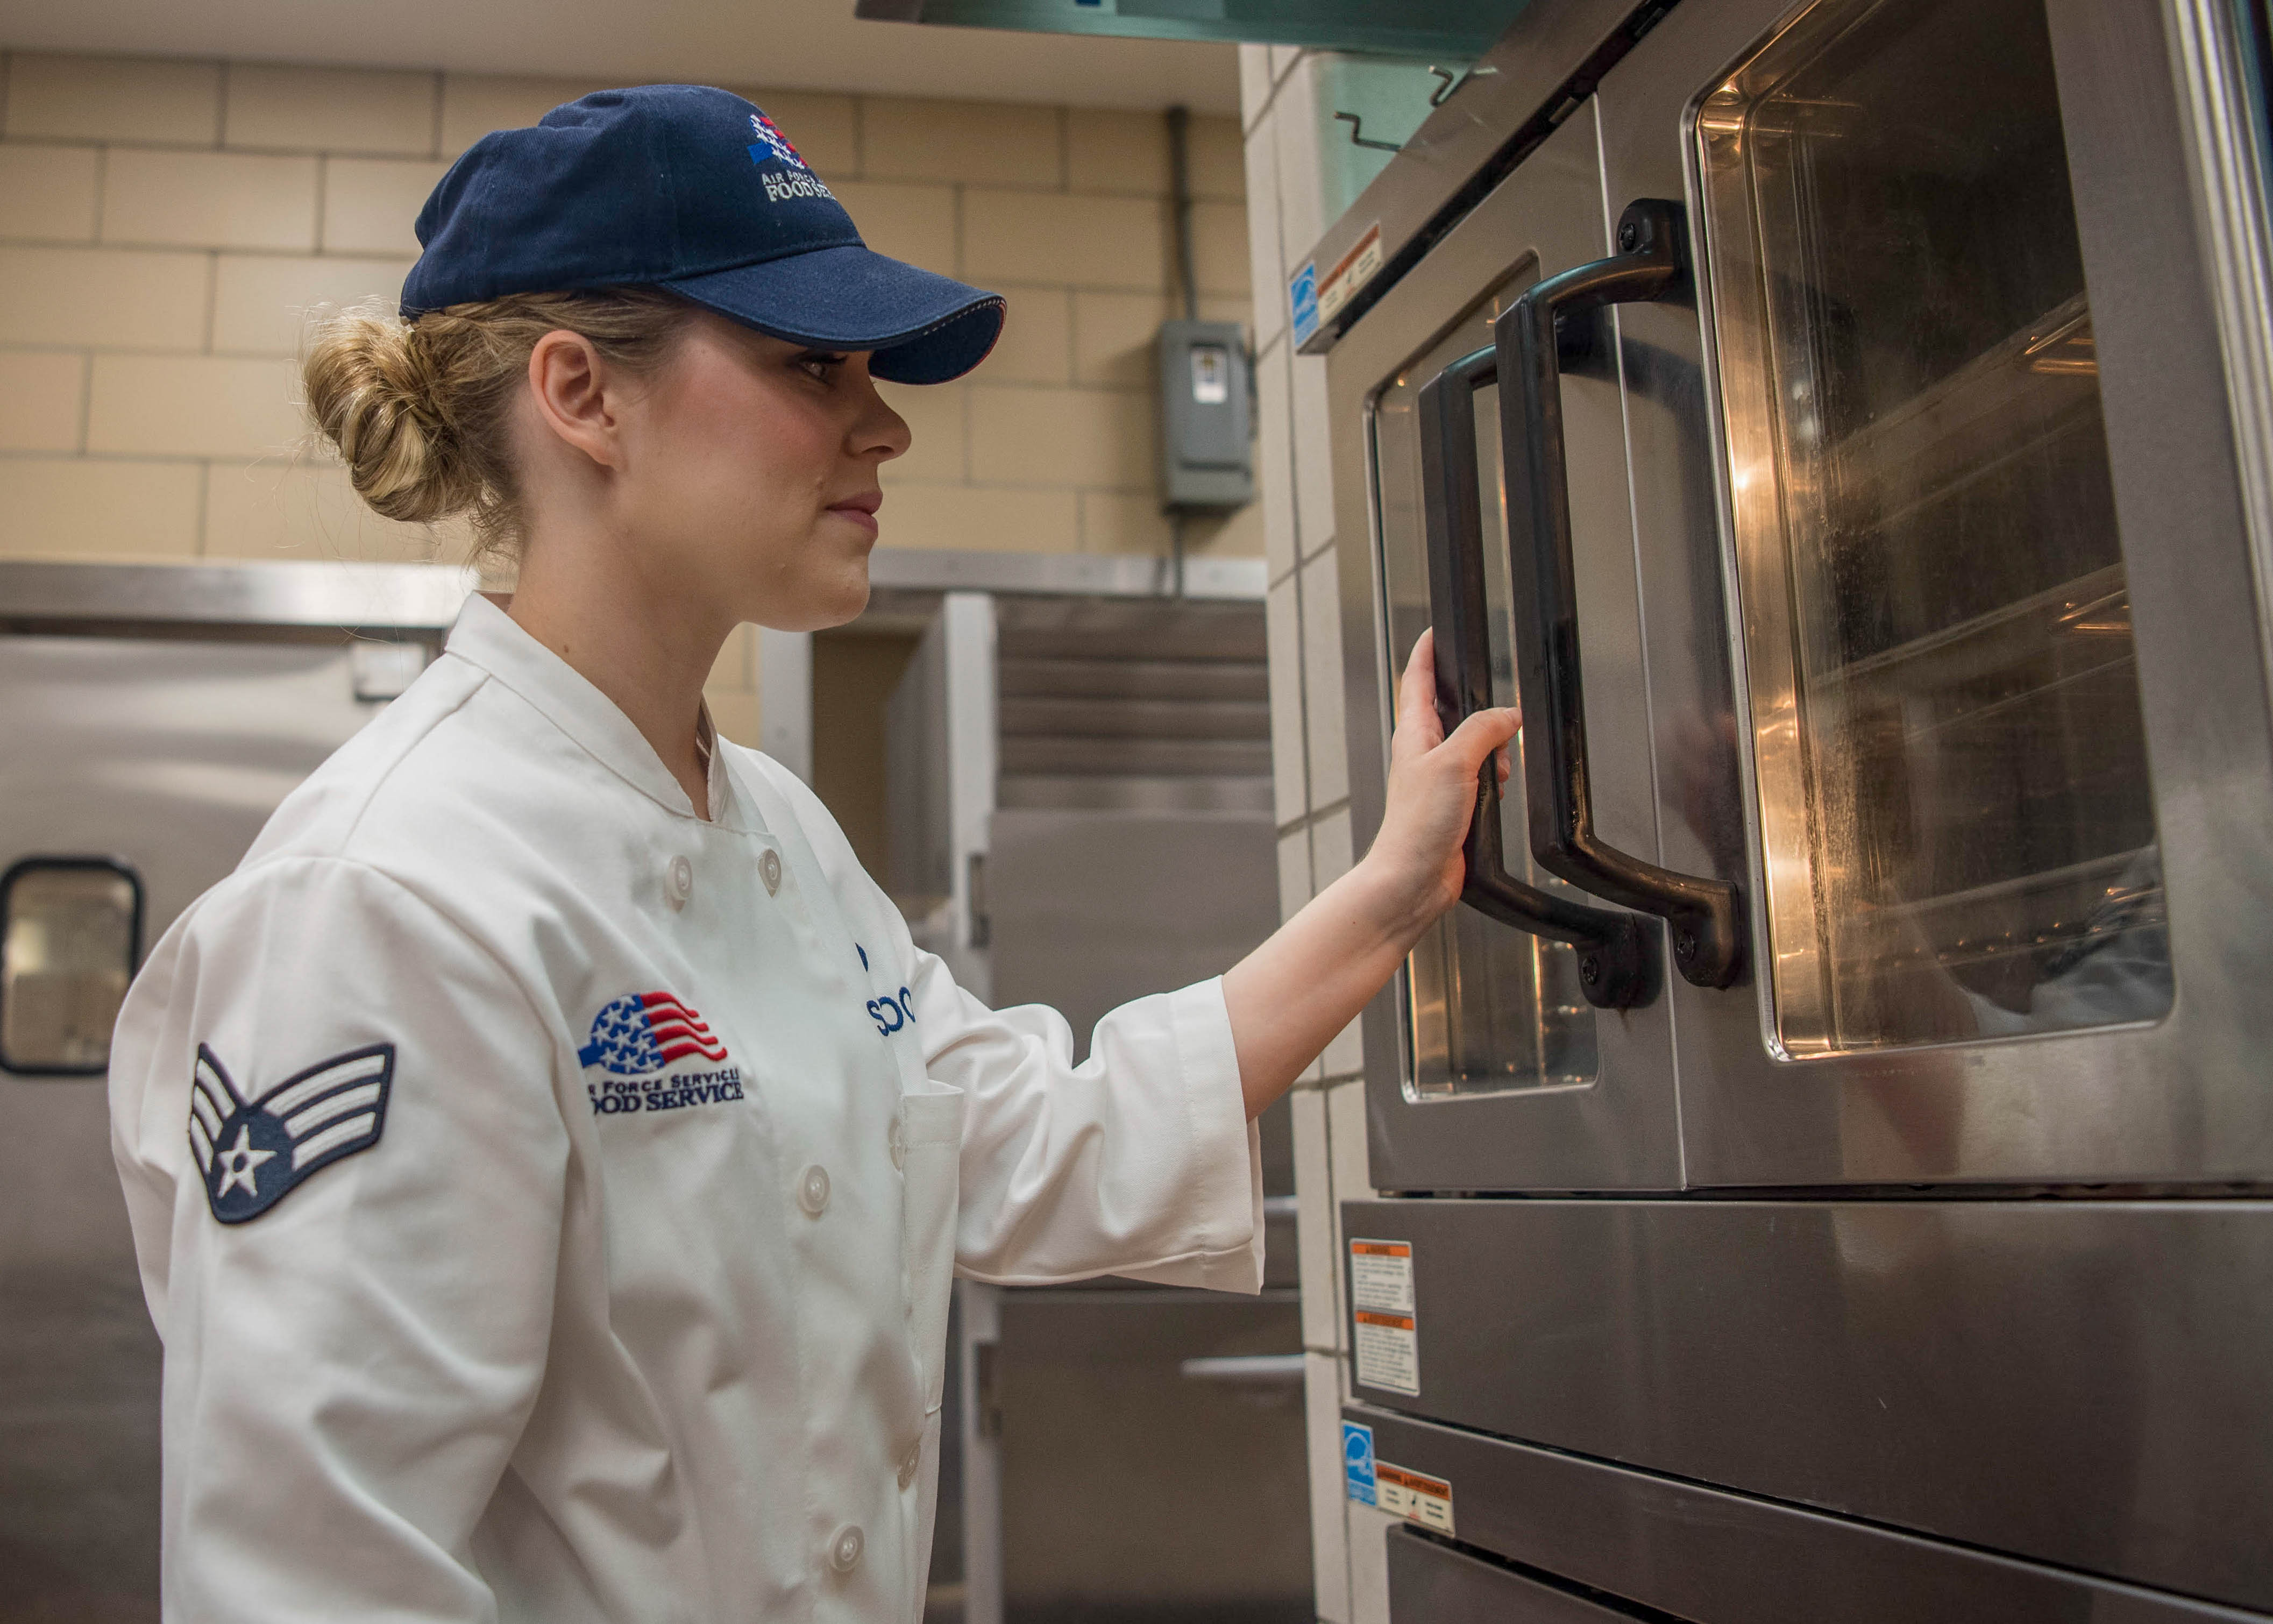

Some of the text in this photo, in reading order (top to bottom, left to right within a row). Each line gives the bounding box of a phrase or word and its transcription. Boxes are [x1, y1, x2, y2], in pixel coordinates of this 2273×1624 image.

[762, 173, 785, 186] AIR
[765, 180, 814, 202] FOOD
[603, 1079, 663, 1094] FORCE
[646, 1082, 745, 1111] SERVICE
